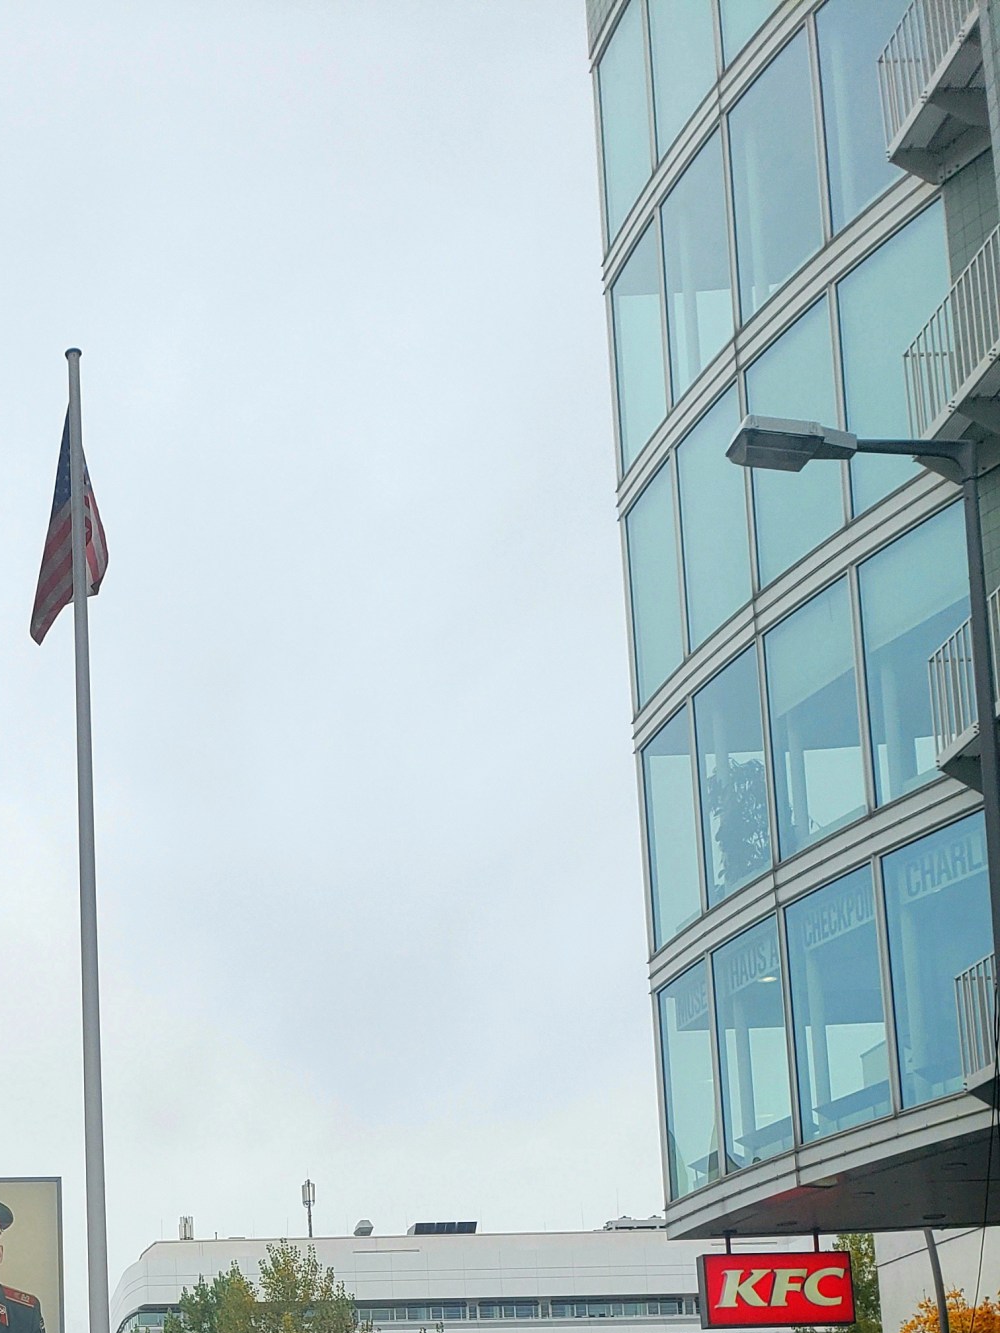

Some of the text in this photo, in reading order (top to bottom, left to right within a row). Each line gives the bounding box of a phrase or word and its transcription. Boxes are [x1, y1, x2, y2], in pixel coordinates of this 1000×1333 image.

[804, 886, 873, 947] CHECKPOI
[905, 835, 986, 897] CHARL
[716, 1267, 846, 1309] KFC
